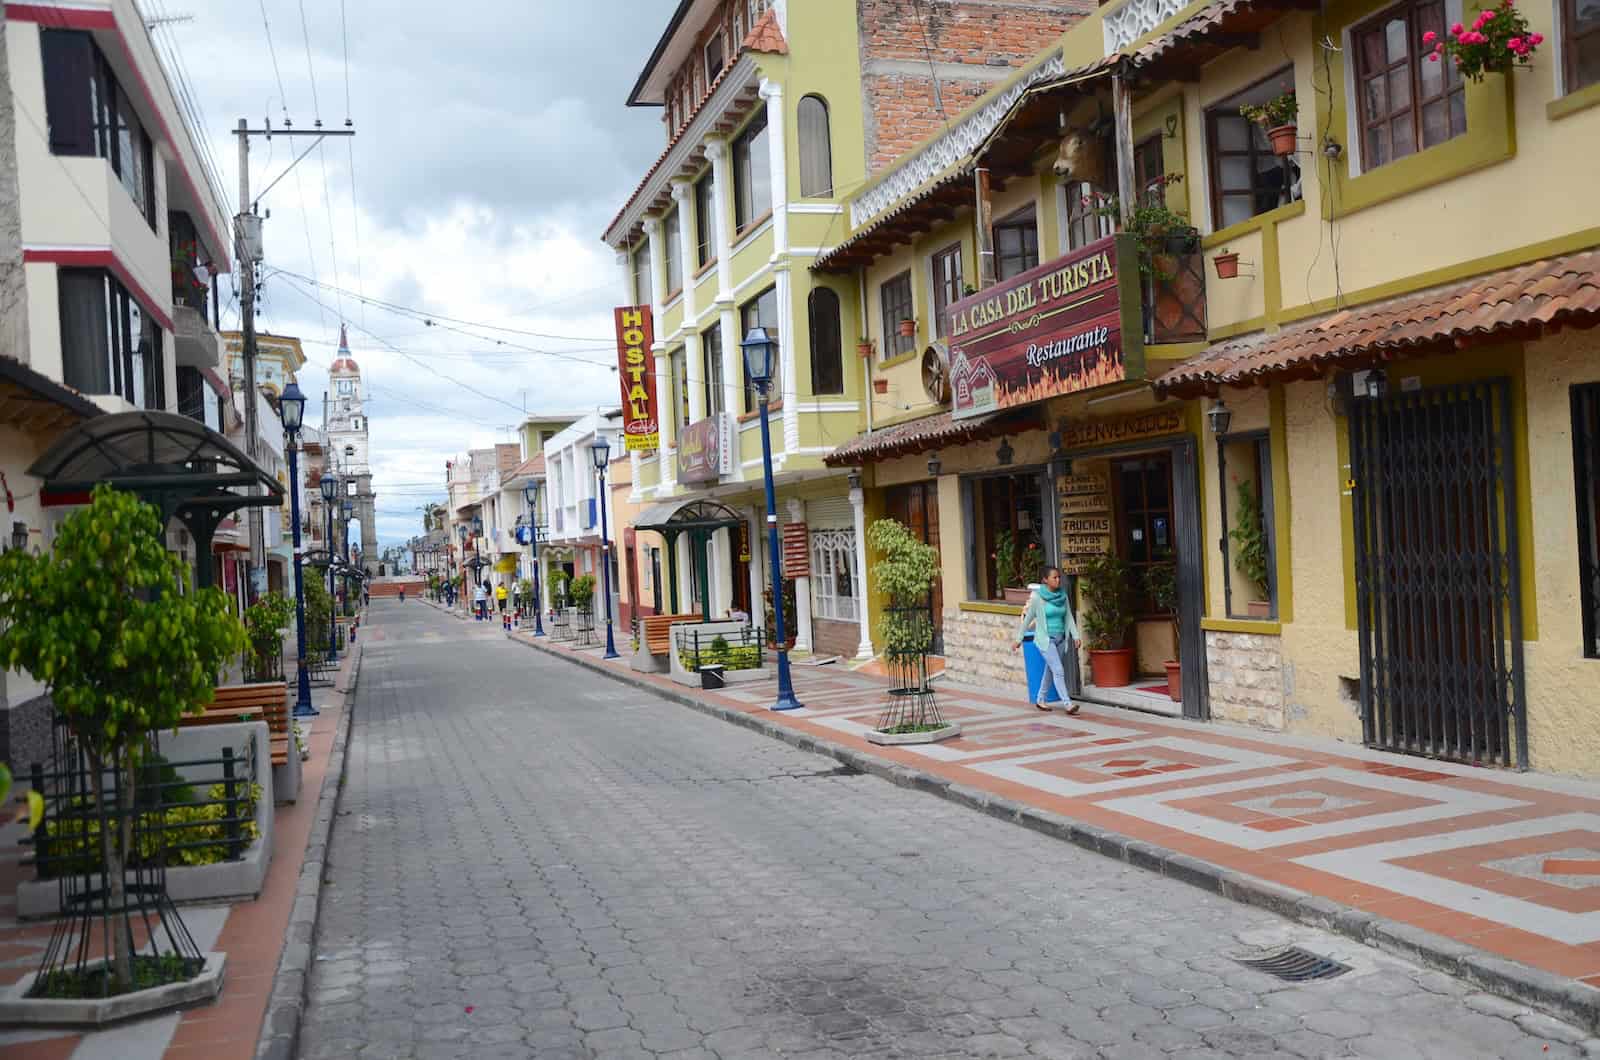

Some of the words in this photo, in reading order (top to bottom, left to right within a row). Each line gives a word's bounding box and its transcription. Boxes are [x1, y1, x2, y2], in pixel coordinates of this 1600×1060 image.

[951, 313, 968, 337] LA
[970, 304, 1003, 331] CASA
[1006, 288, 1037, 316] DEL
[1039, 251, 1113, 301] TURISTA
[623, 311, 648, 419] HOSTAL
[1026, 325, 1108, 366] Restaurante
[1063, 519, 1109, 531] TRUCHAS
